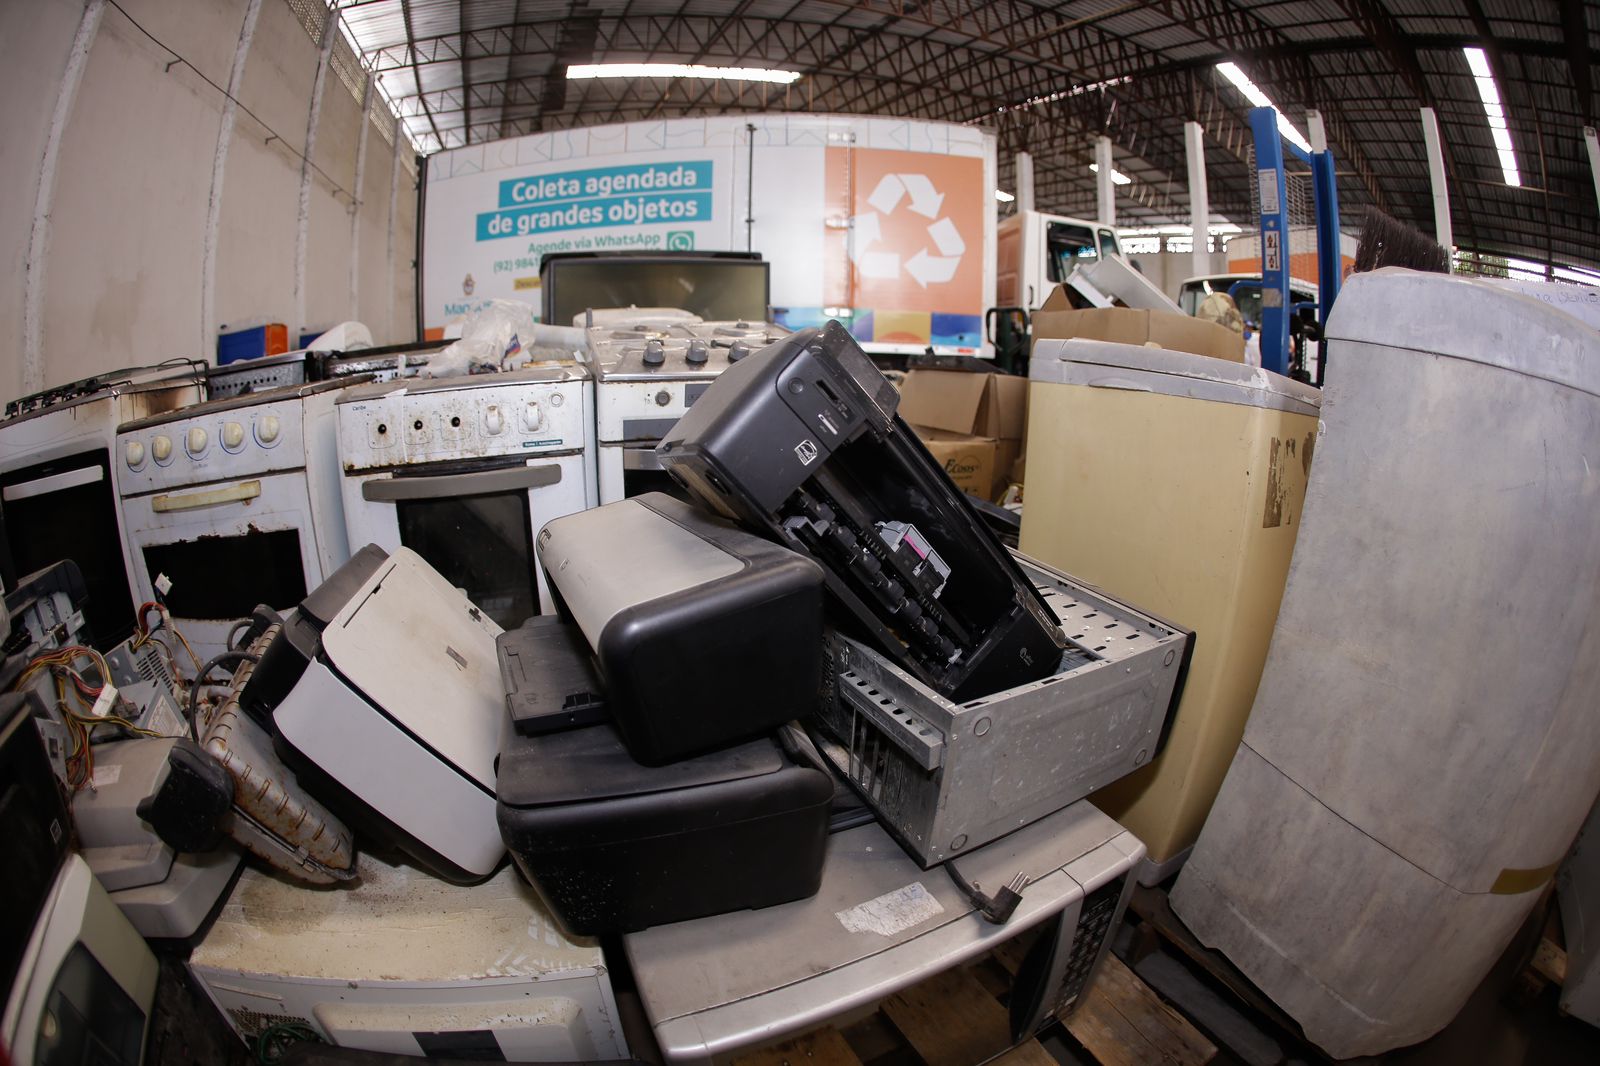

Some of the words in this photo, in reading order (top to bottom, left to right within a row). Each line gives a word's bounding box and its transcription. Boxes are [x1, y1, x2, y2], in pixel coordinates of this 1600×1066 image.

[511, 178, 580, 202] Coleta
[585, 166, 697, 196] agendada
[487, 214, 513, 234] de
[517, 205, 603, 235] grandes
[608, 198, 698, 224] objetos
[528, 239, 571, 254] Agende
[574, 237, 592, 249] via
[595, 233, 660, 249] WhatsApp
[493, 260, 512, 275] (92)
